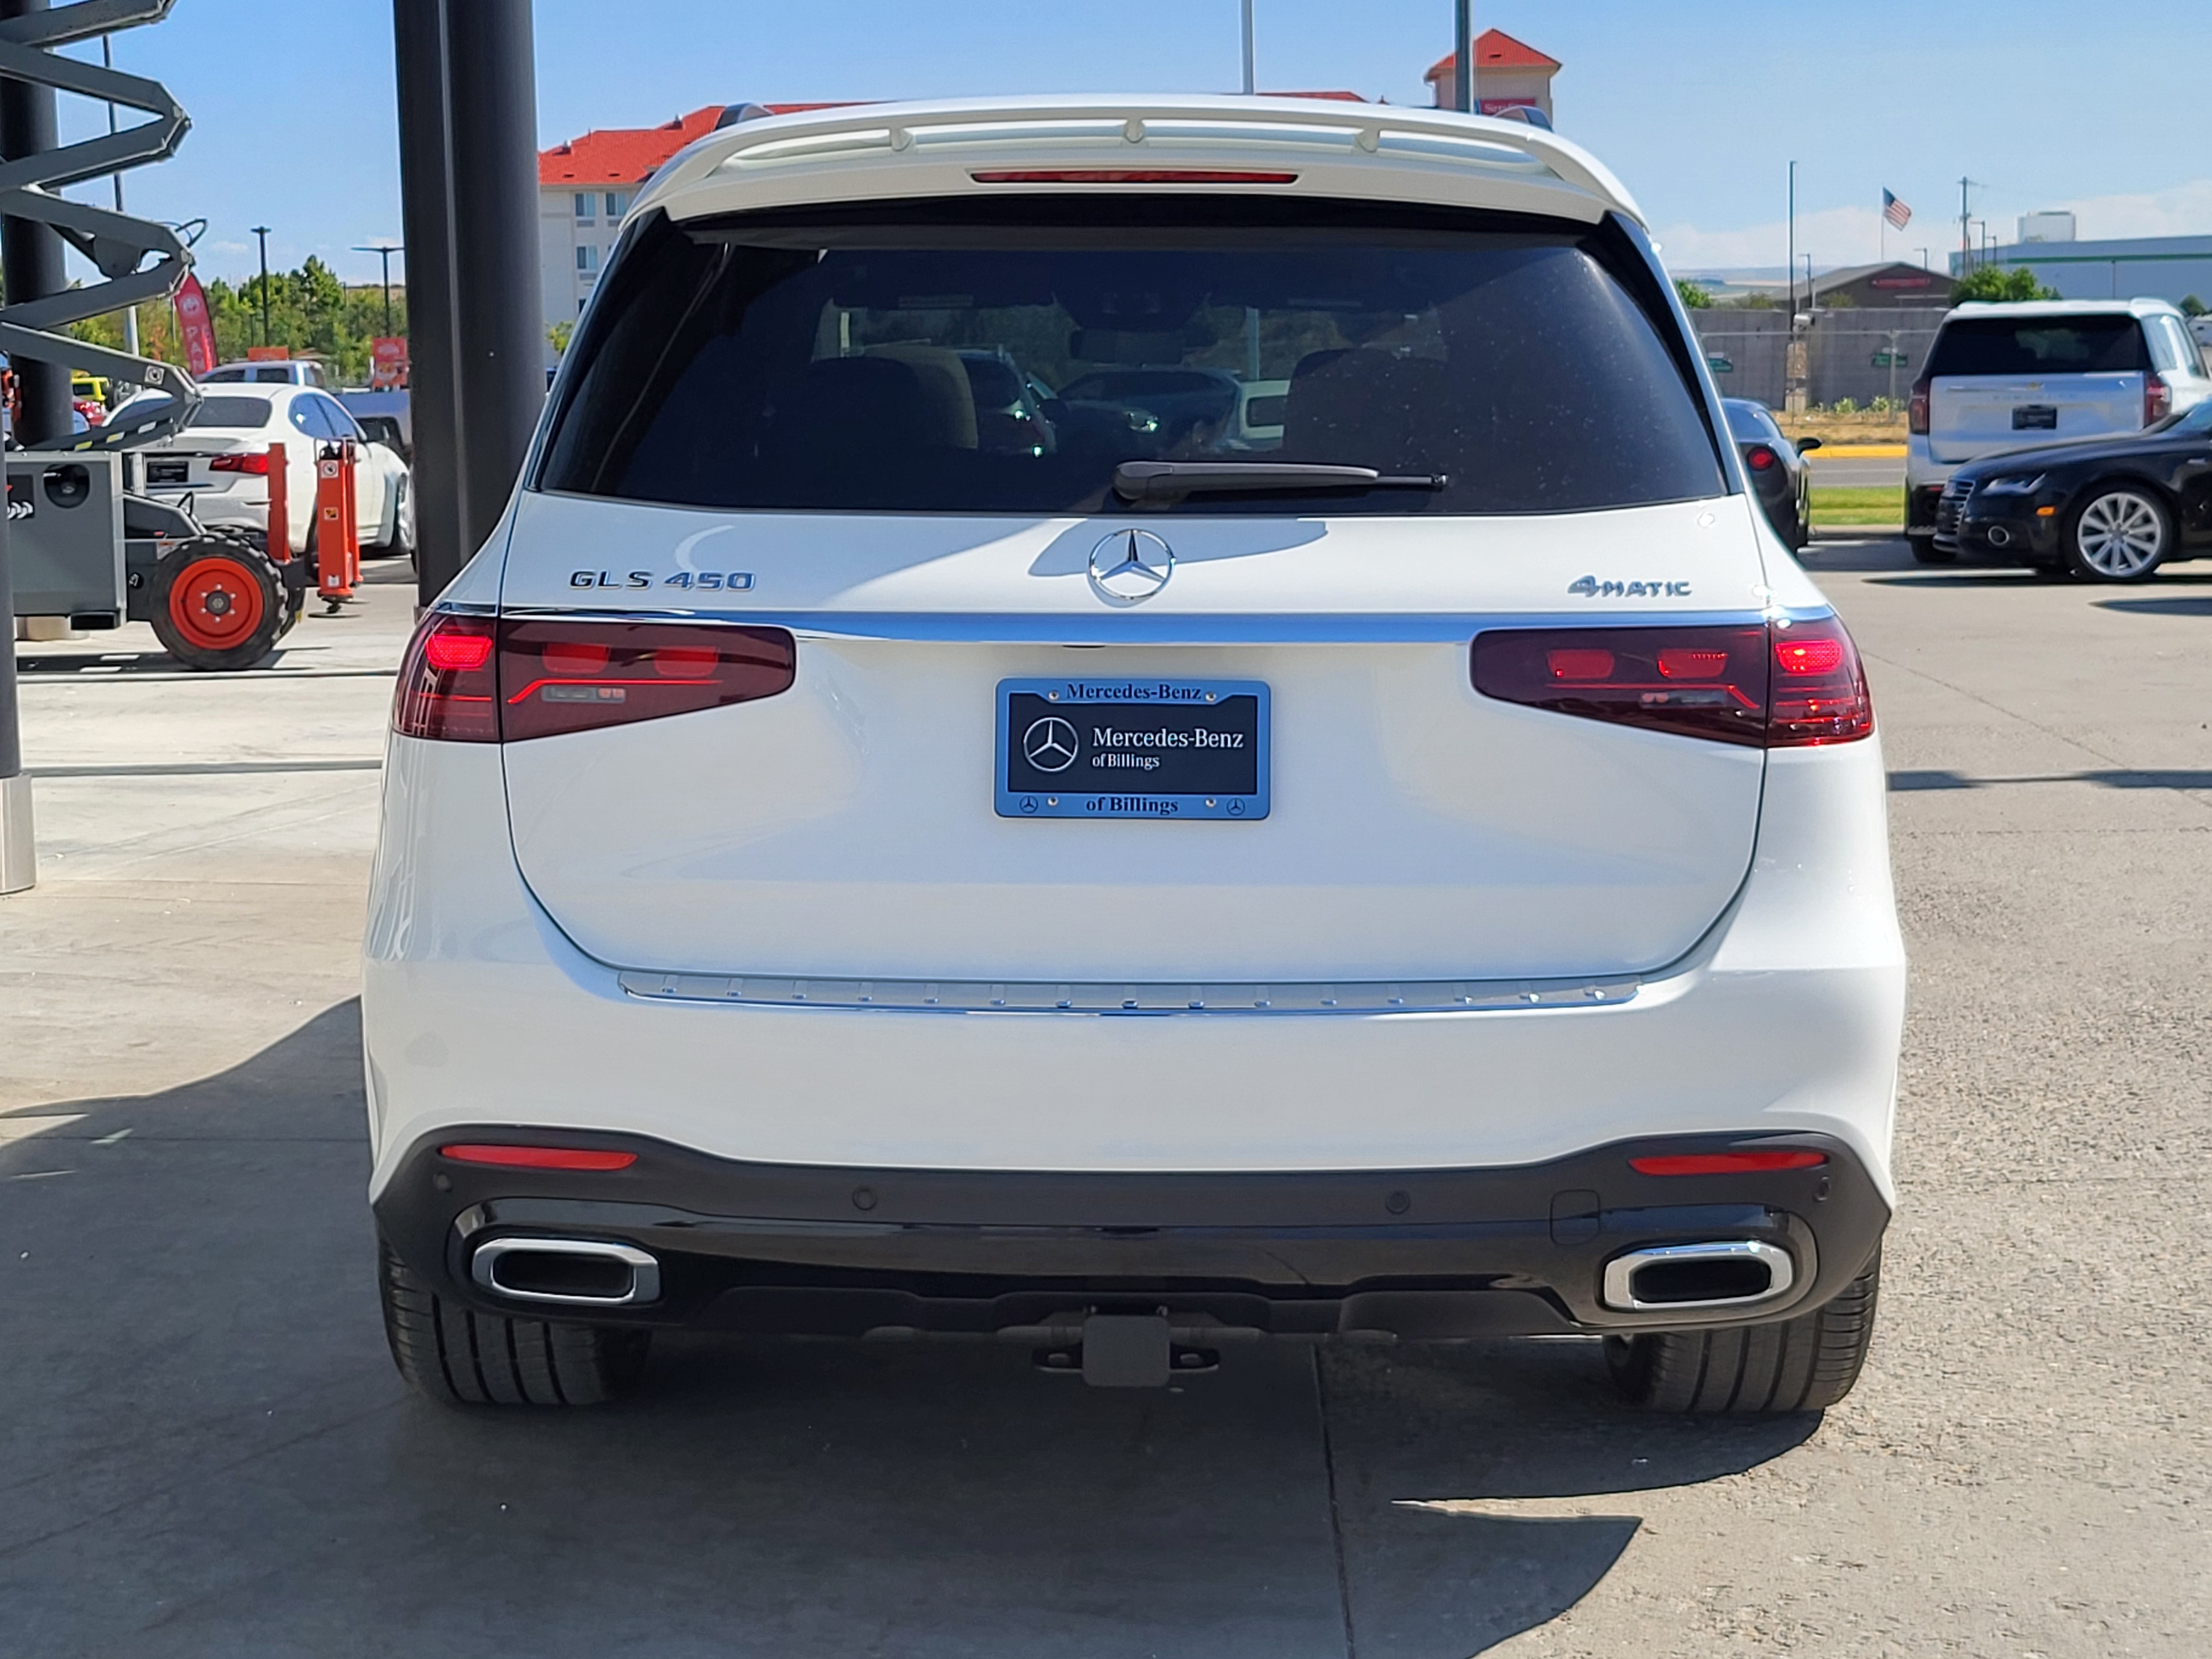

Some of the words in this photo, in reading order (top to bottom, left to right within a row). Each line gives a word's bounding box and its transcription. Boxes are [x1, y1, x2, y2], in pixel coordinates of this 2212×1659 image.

[570, 571, 654, 590] GLS
[664, 572, 756, 591] 450
[1567, 575, 1692, 598] 4MATIC
[1066, 683, 1202, 700] Mercedes-Benz
[1092, 727, 1244, 748] Mercedes-Benz
[1092, 754, 1107, 768] of
[1108, 754, 1160, 770] Billings
[1086, 797, 1107, 812] of
[1110, 797, 1179, 815] Billings
